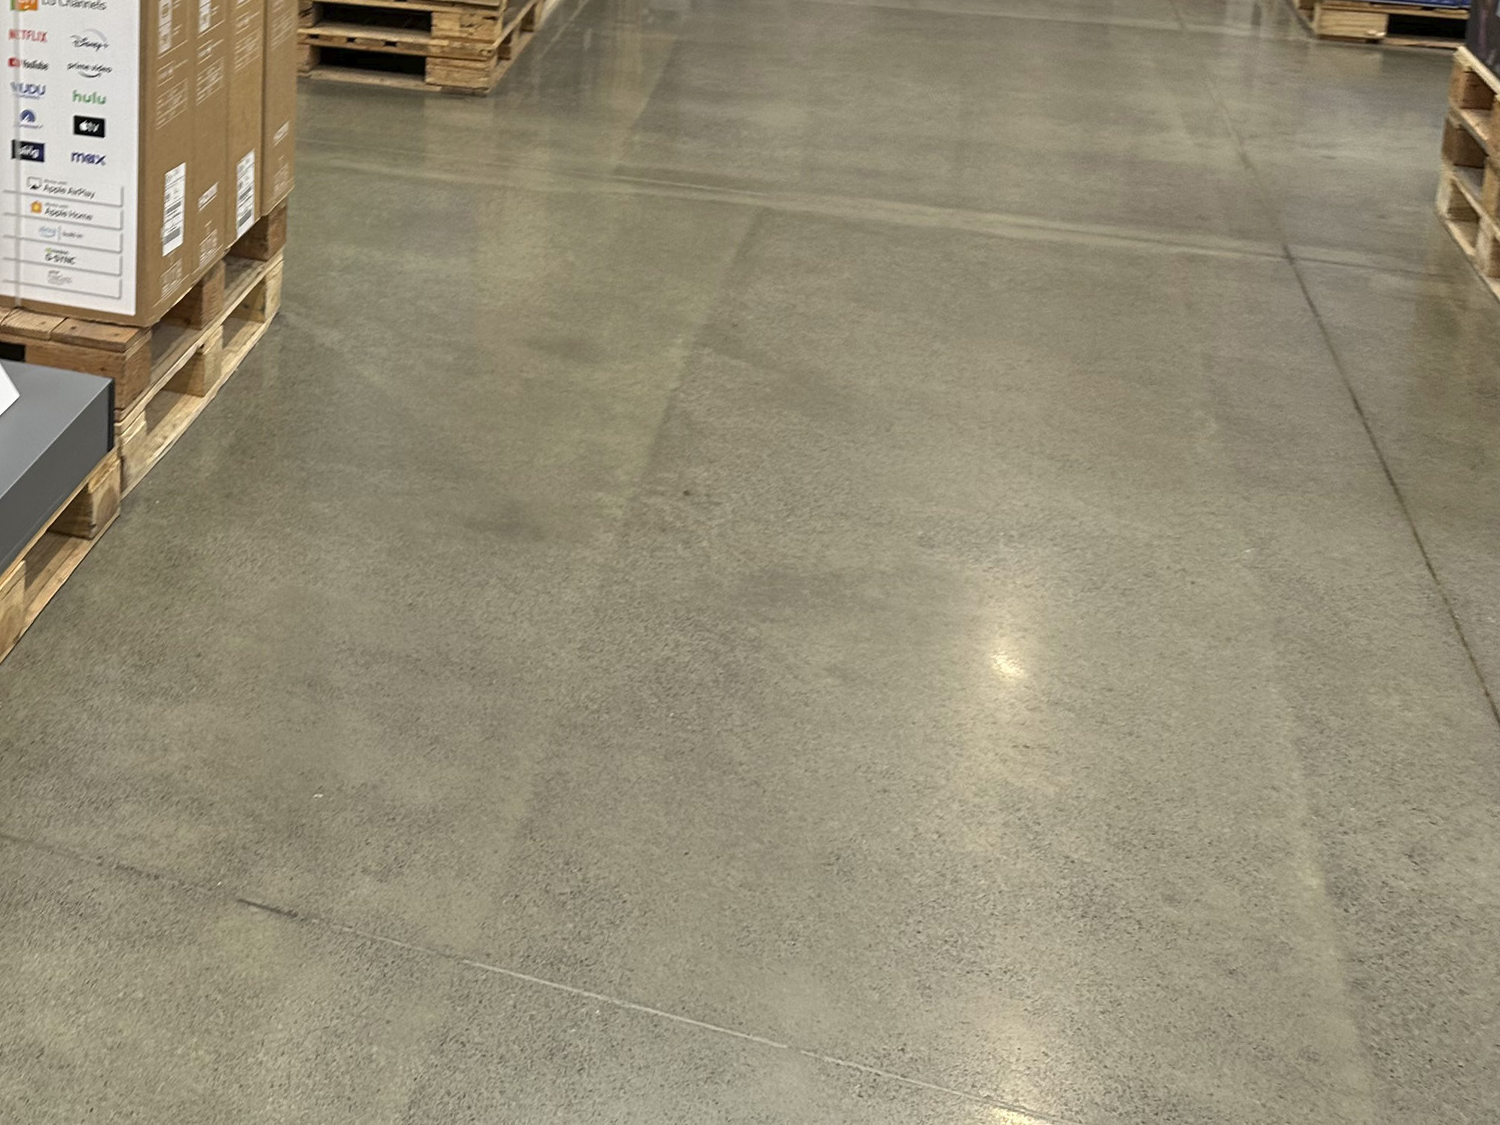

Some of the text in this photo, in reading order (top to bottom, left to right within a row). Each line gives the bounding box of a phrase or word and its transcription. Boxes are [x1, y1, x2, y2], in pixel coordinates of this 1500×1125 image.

[9, 30, 48, 43] NETFLIX
[72, 90, 106, 105] hulu
[71, 151, 106, 166] max
